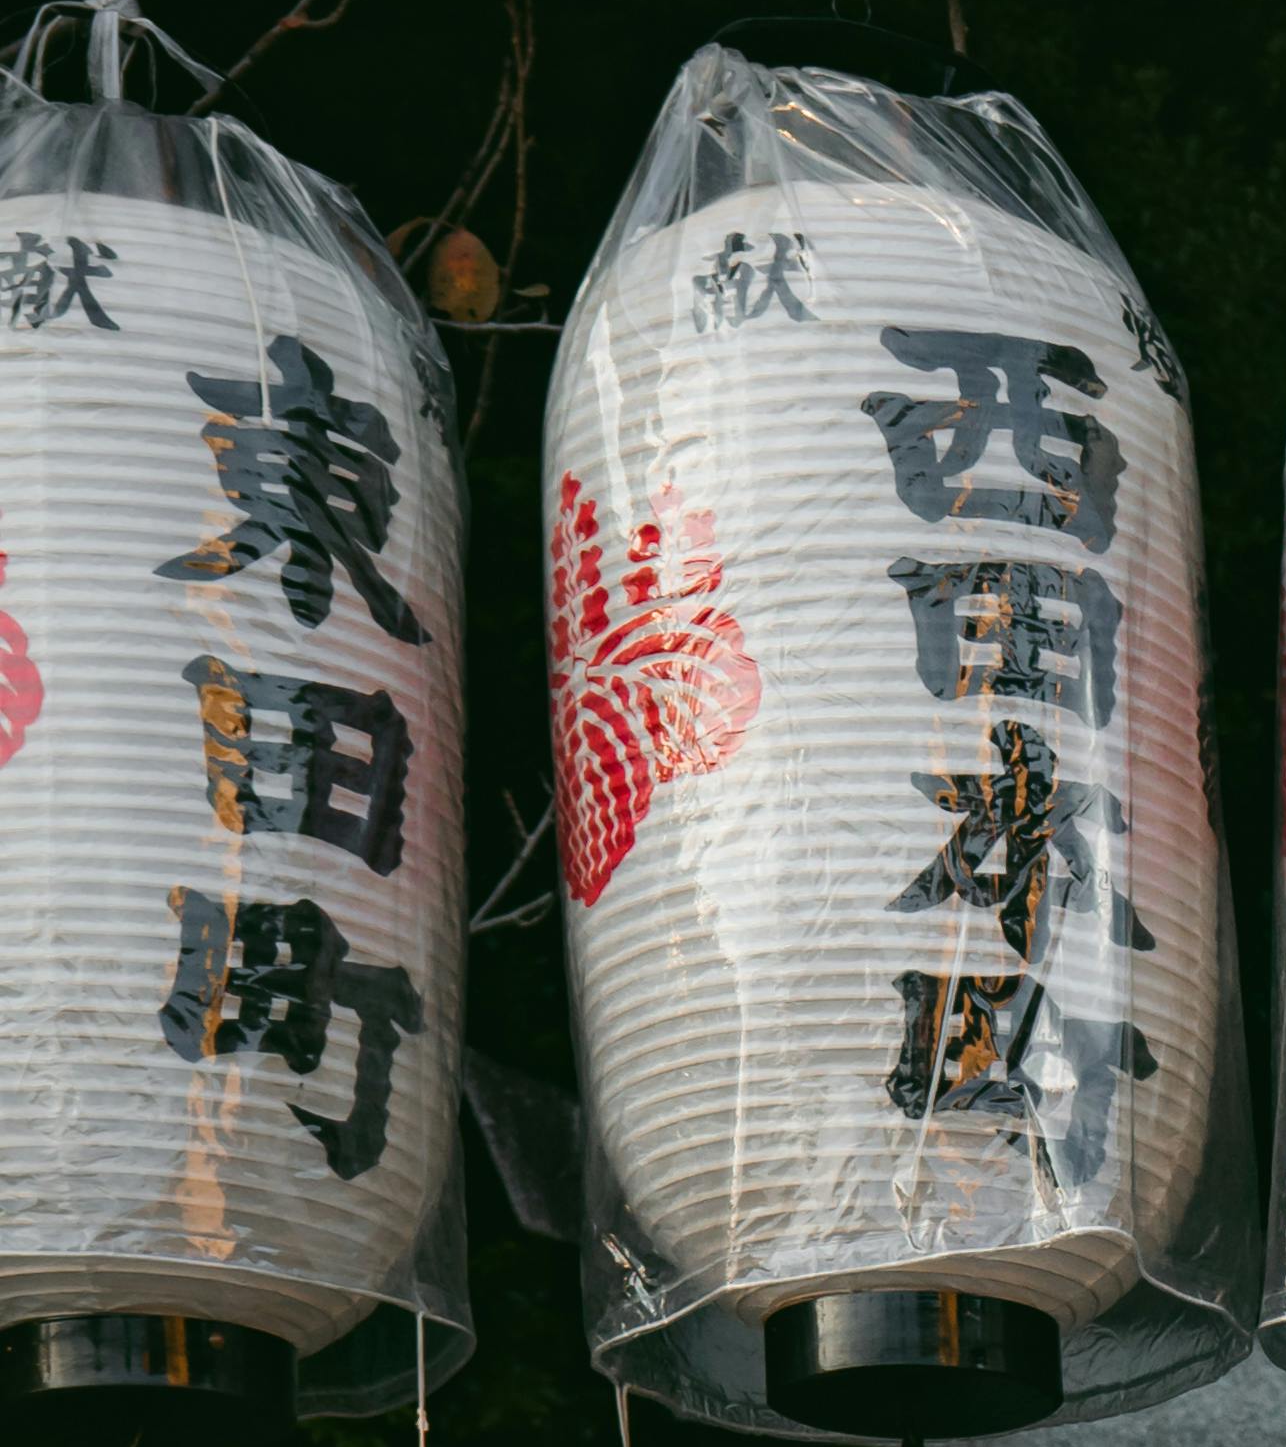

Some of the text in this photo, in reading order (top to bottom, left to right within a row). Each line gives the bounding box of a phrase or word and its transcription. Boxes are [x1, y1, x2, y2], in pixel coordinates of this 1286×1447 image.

[690, 231, 821, 329] 献
[152, 335, 433, 1181] 東田町
